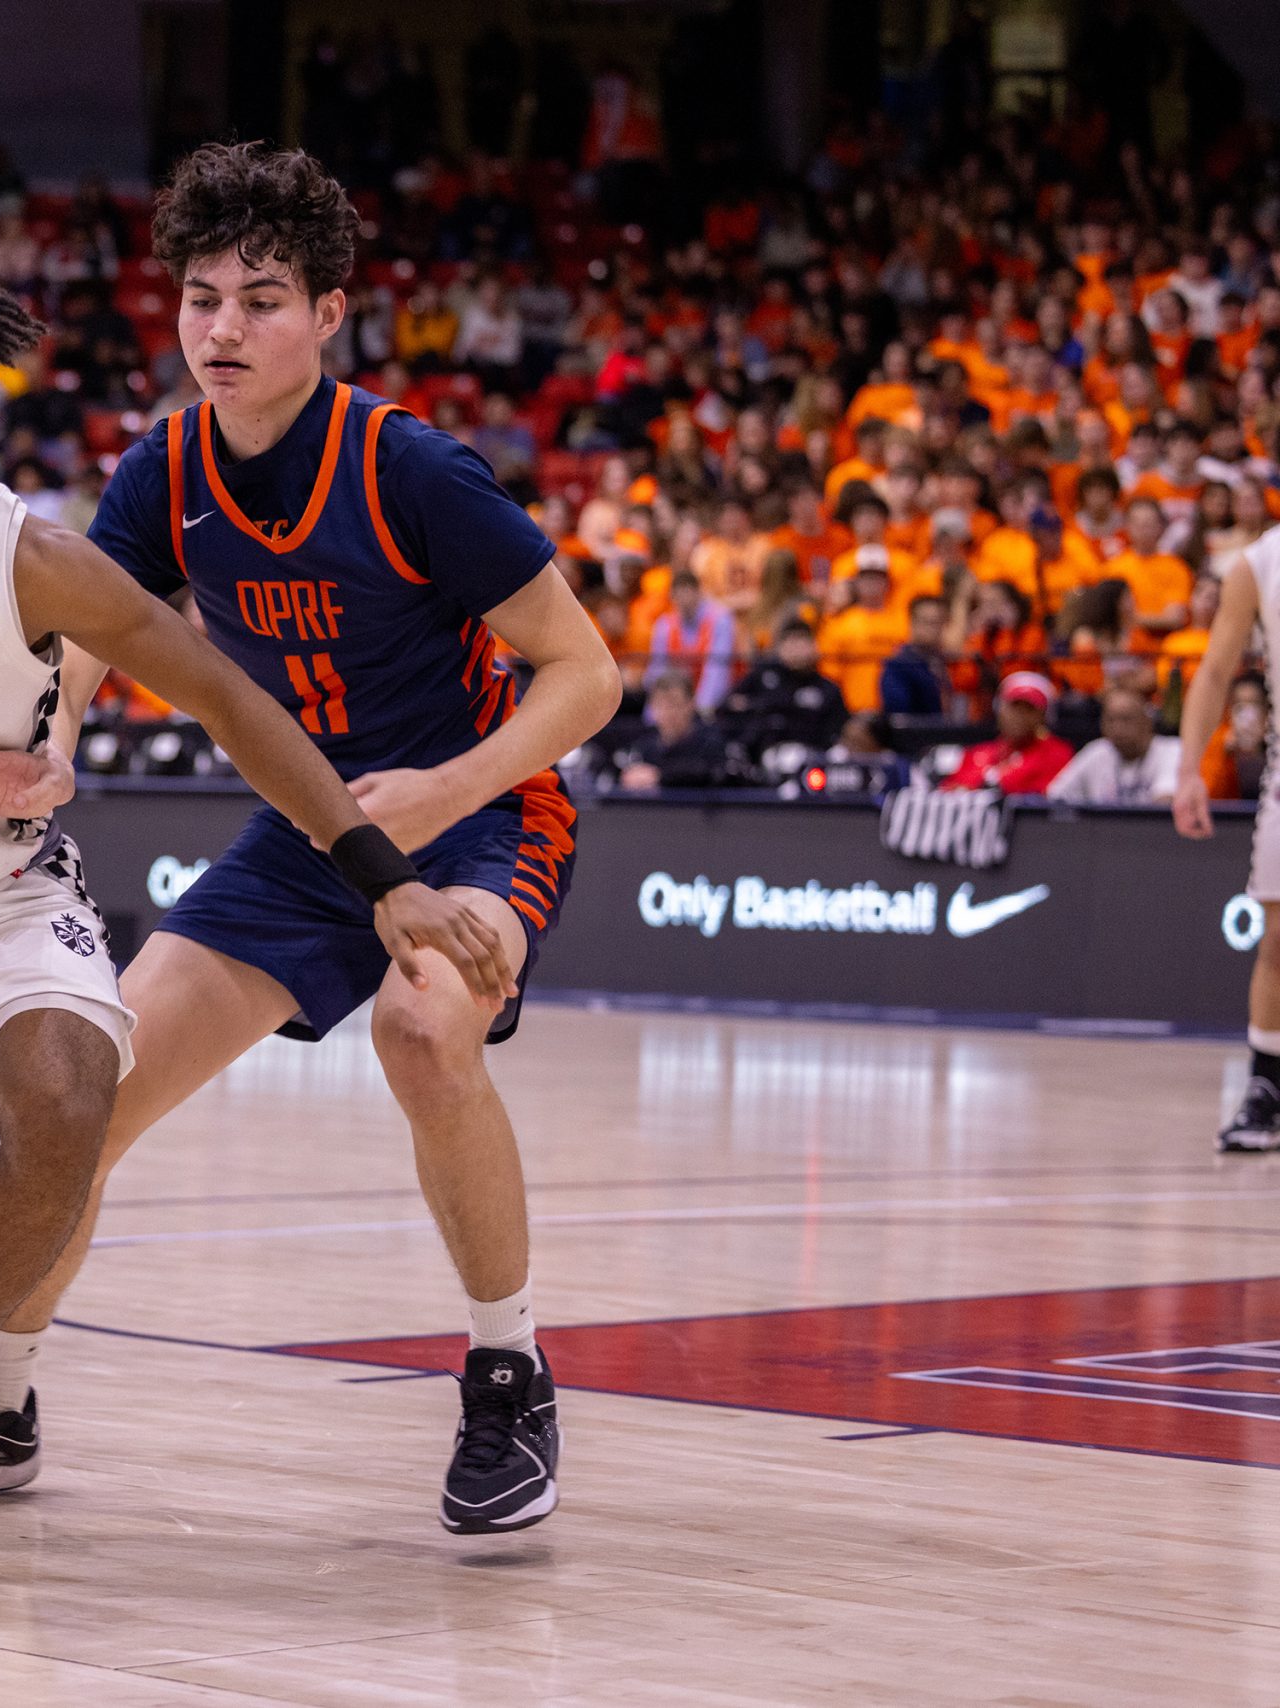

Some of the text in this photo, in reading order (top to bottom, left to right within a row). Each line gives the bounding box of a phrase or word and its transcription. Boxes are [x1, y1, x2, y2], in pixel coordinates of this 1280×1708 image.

[236, 580, 344, 641] OPRF
[284, 652, 349, 734] 11
[639, 871, 937, 937] Only Basketball
